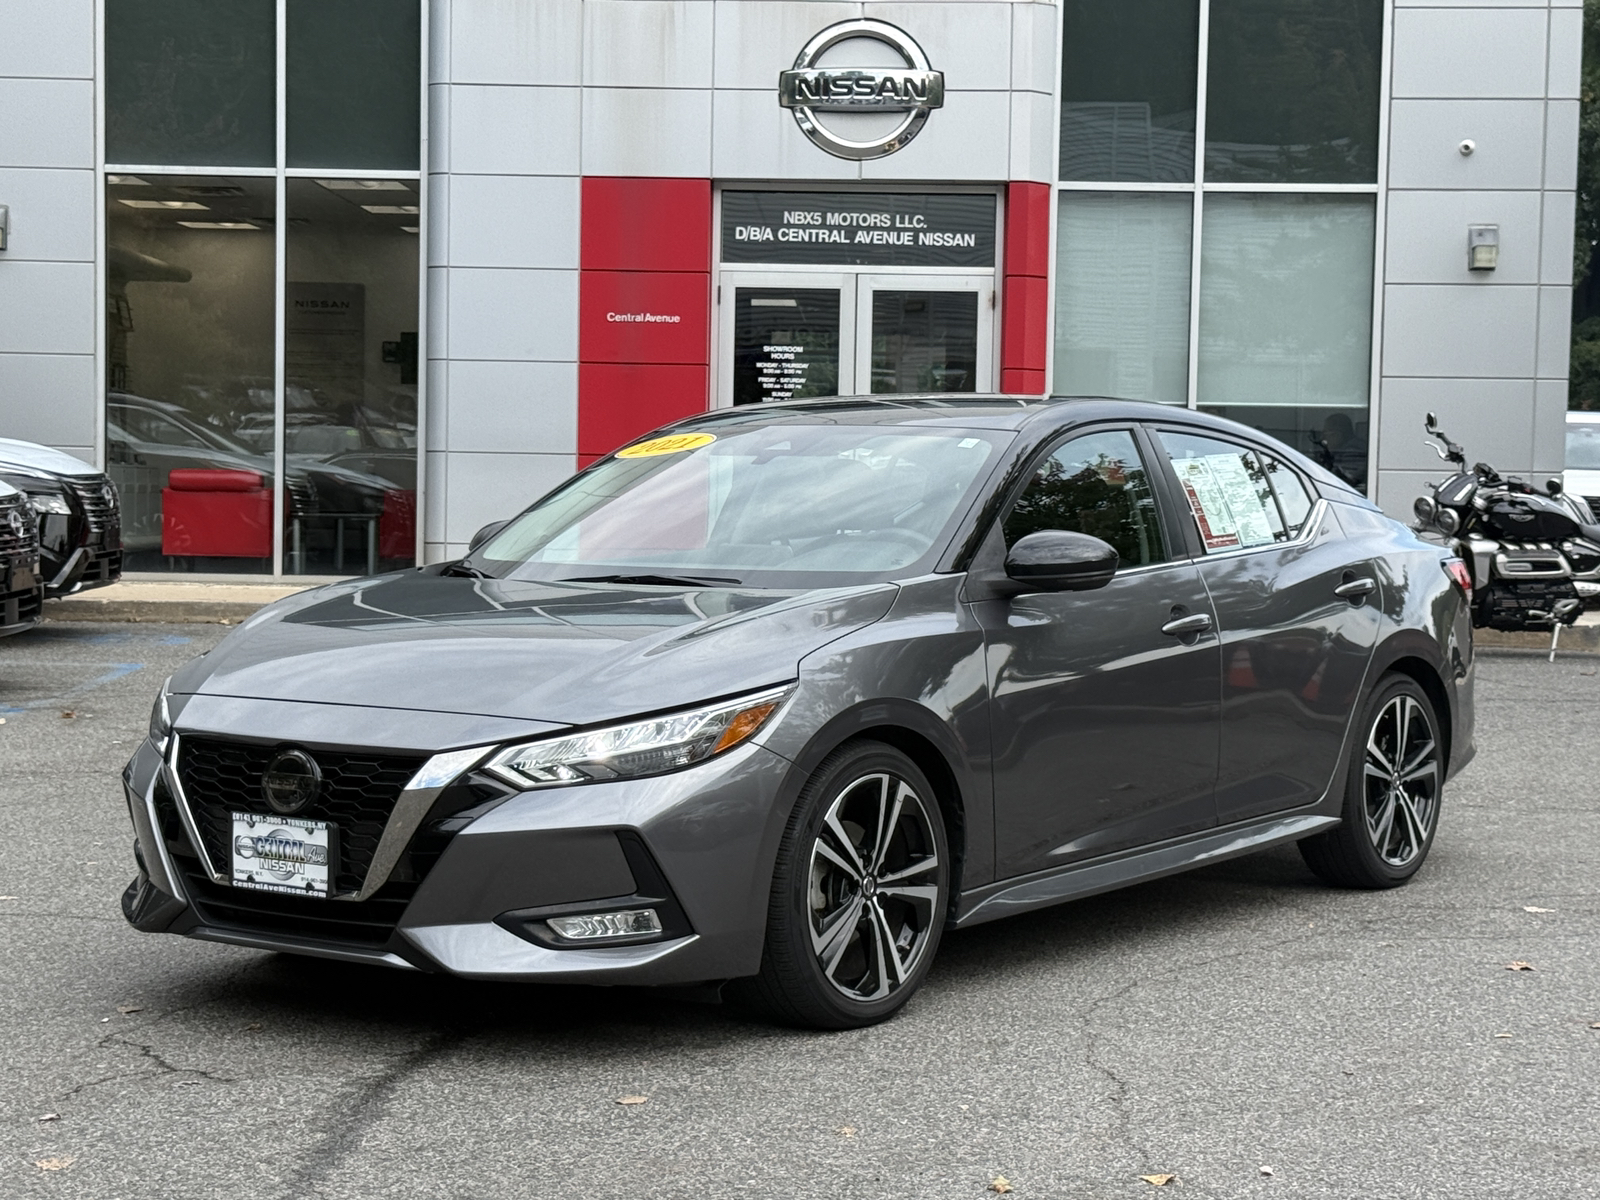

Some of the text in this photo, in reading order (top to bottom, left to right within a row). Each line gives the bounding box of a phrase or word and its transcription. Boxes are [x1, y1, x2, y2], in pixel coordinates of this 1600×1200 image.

[795, 76, 927, 101] NISSAN
[783, 211, 927, 228] NBX5 MOTORS LLC.
[735, 225, 975, 247] D/B/A CENTRAL AVENUE NISSAN
[295, 300, 350, 309] NISSAN
[606, 312, 681, 323] Central Avenue
[256, 836, 306, 862] CENTRAL
[259, 859, 305, 875] NISSAN
[233, 880, 326, 897] CentralAveNissan.com
